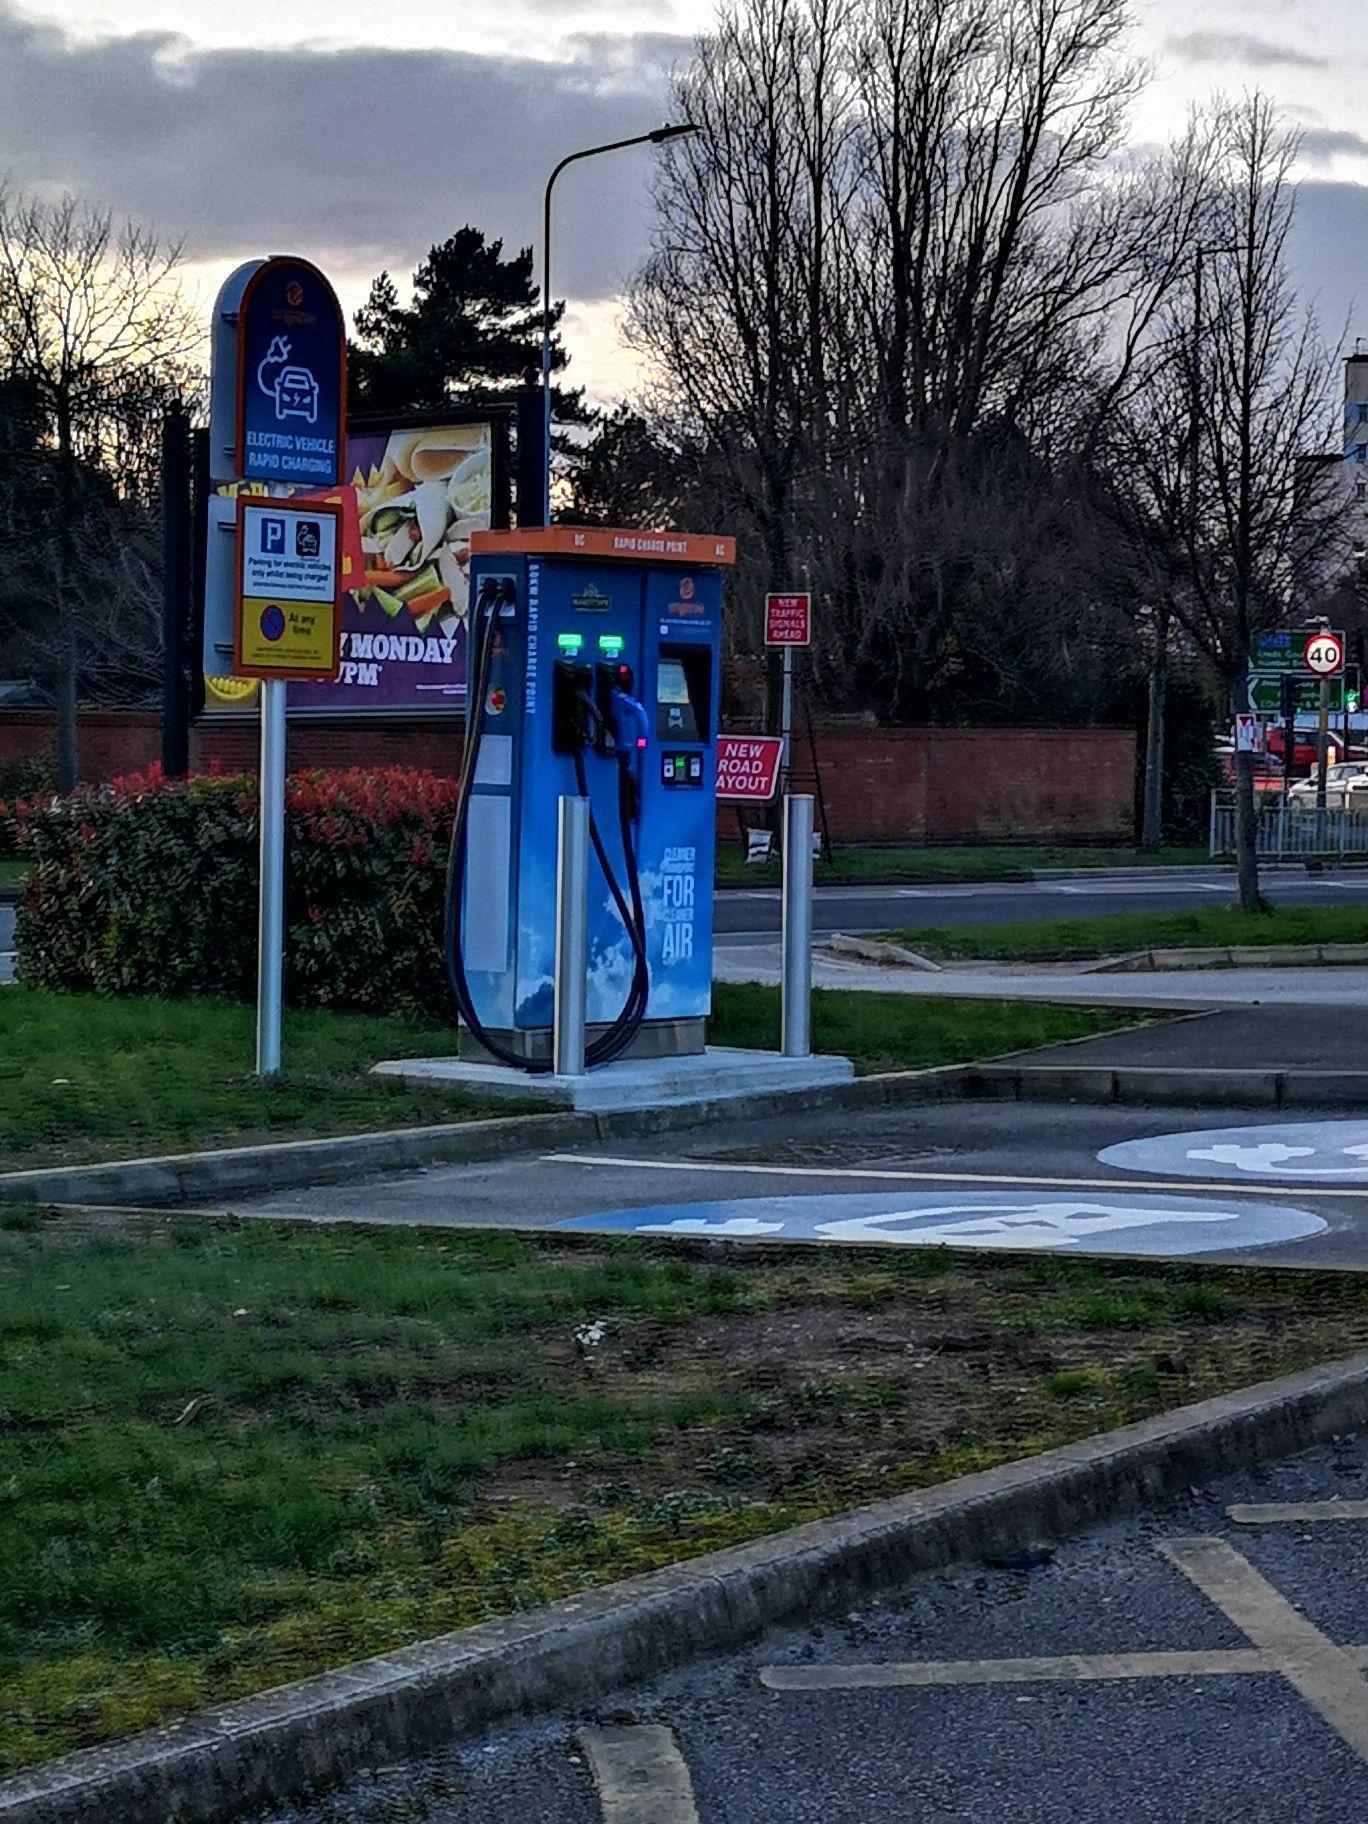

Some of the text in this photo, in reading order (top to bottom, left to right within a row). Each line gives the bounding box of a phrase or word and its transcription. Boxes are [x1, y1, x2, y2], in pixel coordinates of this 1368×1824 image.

[246, 430, 335, 453] ELECTRIC VEHICLE
[248, 451, 332, 474] RAPID CHARGING
[266, 522, 282, 550] P
[350, 632, 457, 664] MONDAY
[1310, 647, 1337, 664] 40
[725, 743, 765, 758] NEW
[717, 758, 763, 774] ROAD
[715, 775, 769, 790] AYOUT
[663, 875, 695, 907] FOR
[662, 922, 694, 958] AIR
